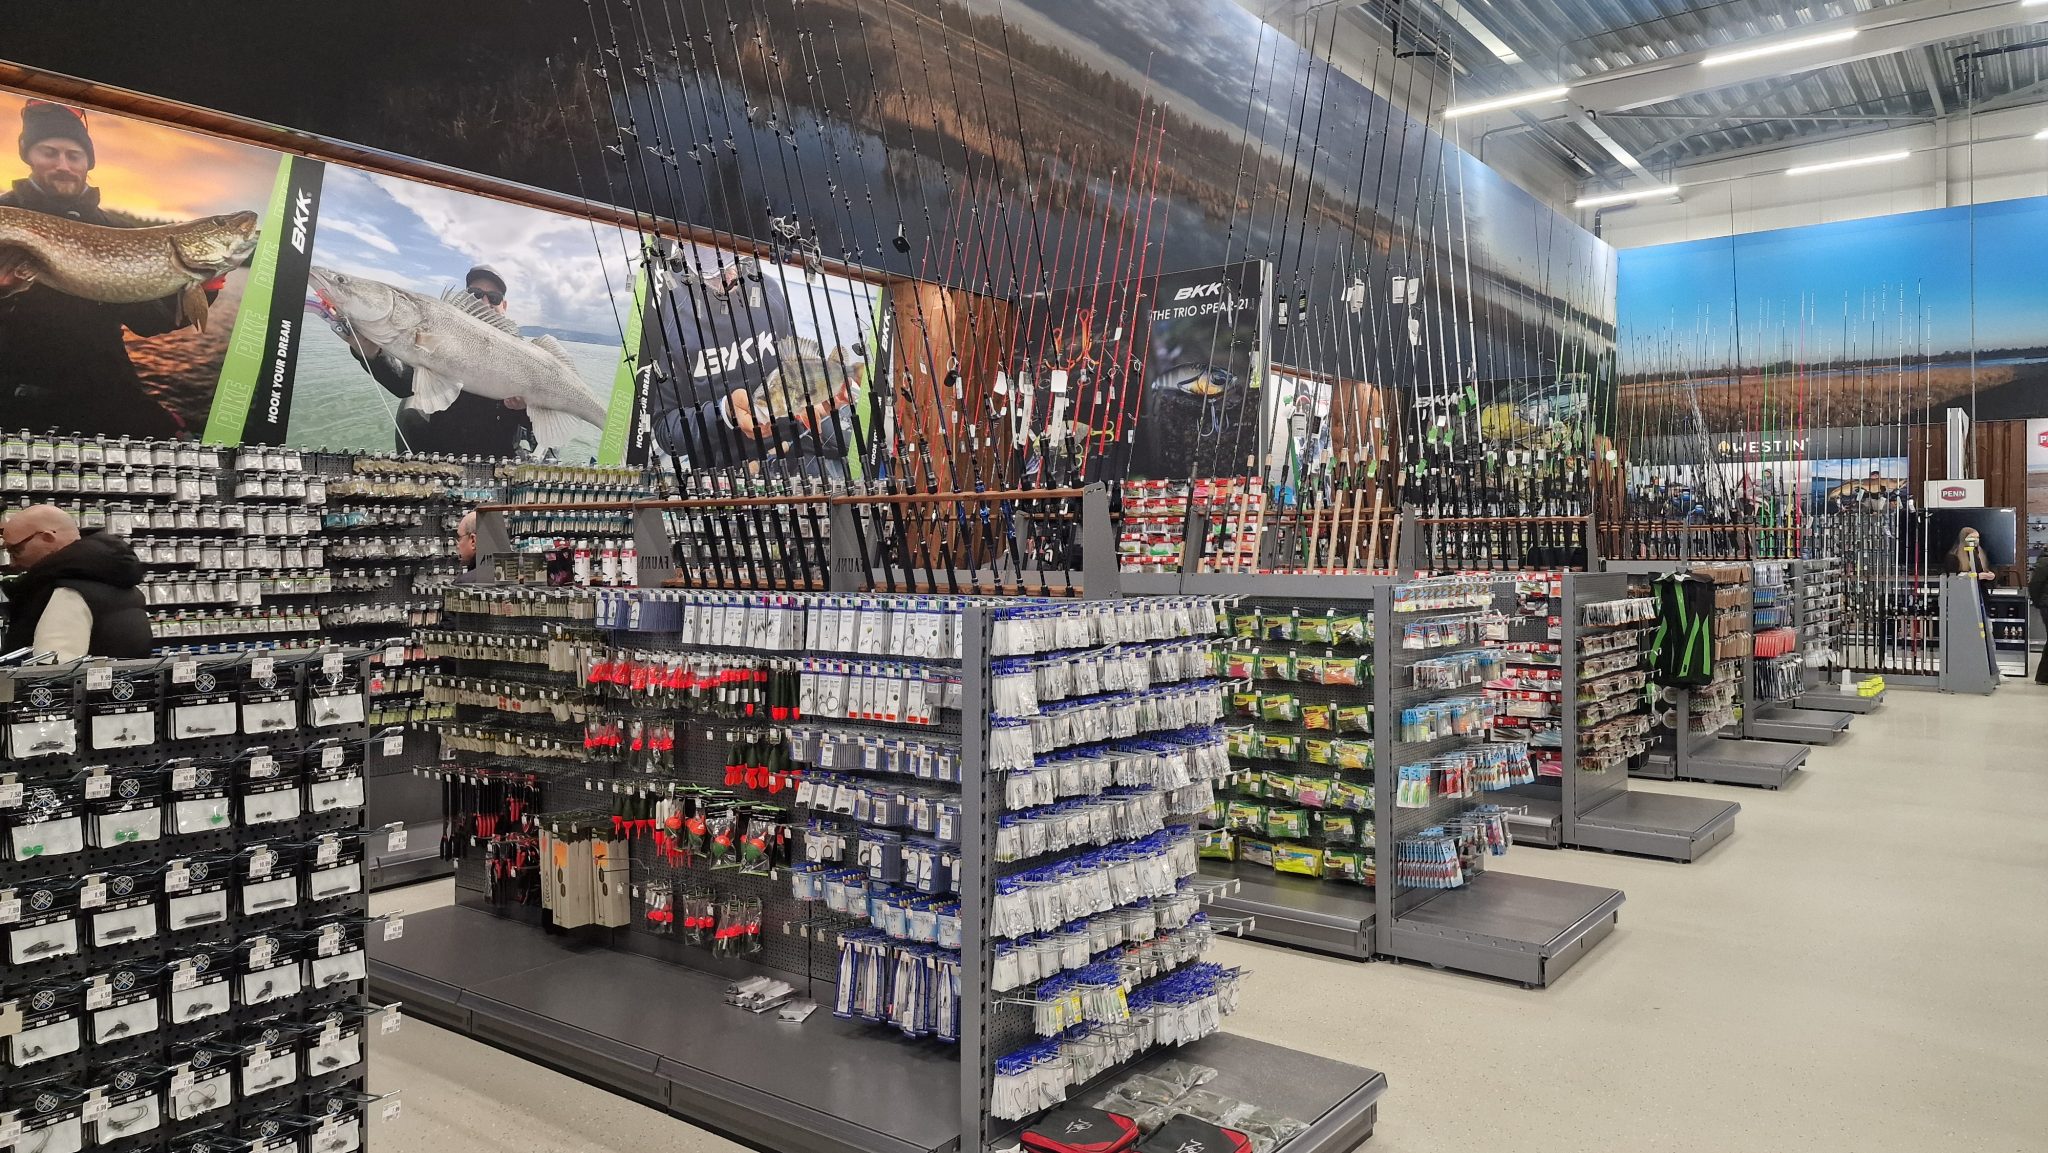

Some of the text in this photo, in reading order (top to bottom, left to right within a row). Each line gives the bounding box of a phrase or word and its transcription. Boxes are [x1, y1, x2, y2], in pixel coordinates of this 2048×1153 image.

[291, 188, 312, 254] BKK
[255, 241, 280, 290] PIKE
[1153, 309, 1171, 321] THE
[1173, 305, 1197, 319] TRIO
[1174, 281, 1222, 300] BKK
[235, 310, 268, 360] PIKE
[693, 331, 778, 378] BKK
[882, 309, 893, 352] BKK
[267, 319, 292, 424] HOOK YOUR DREAM
[215, 379, 250, 430] PIKE
[604, 389, 632, 453] ZANDER
[1732, 440, 1805, 454] WESTIN
